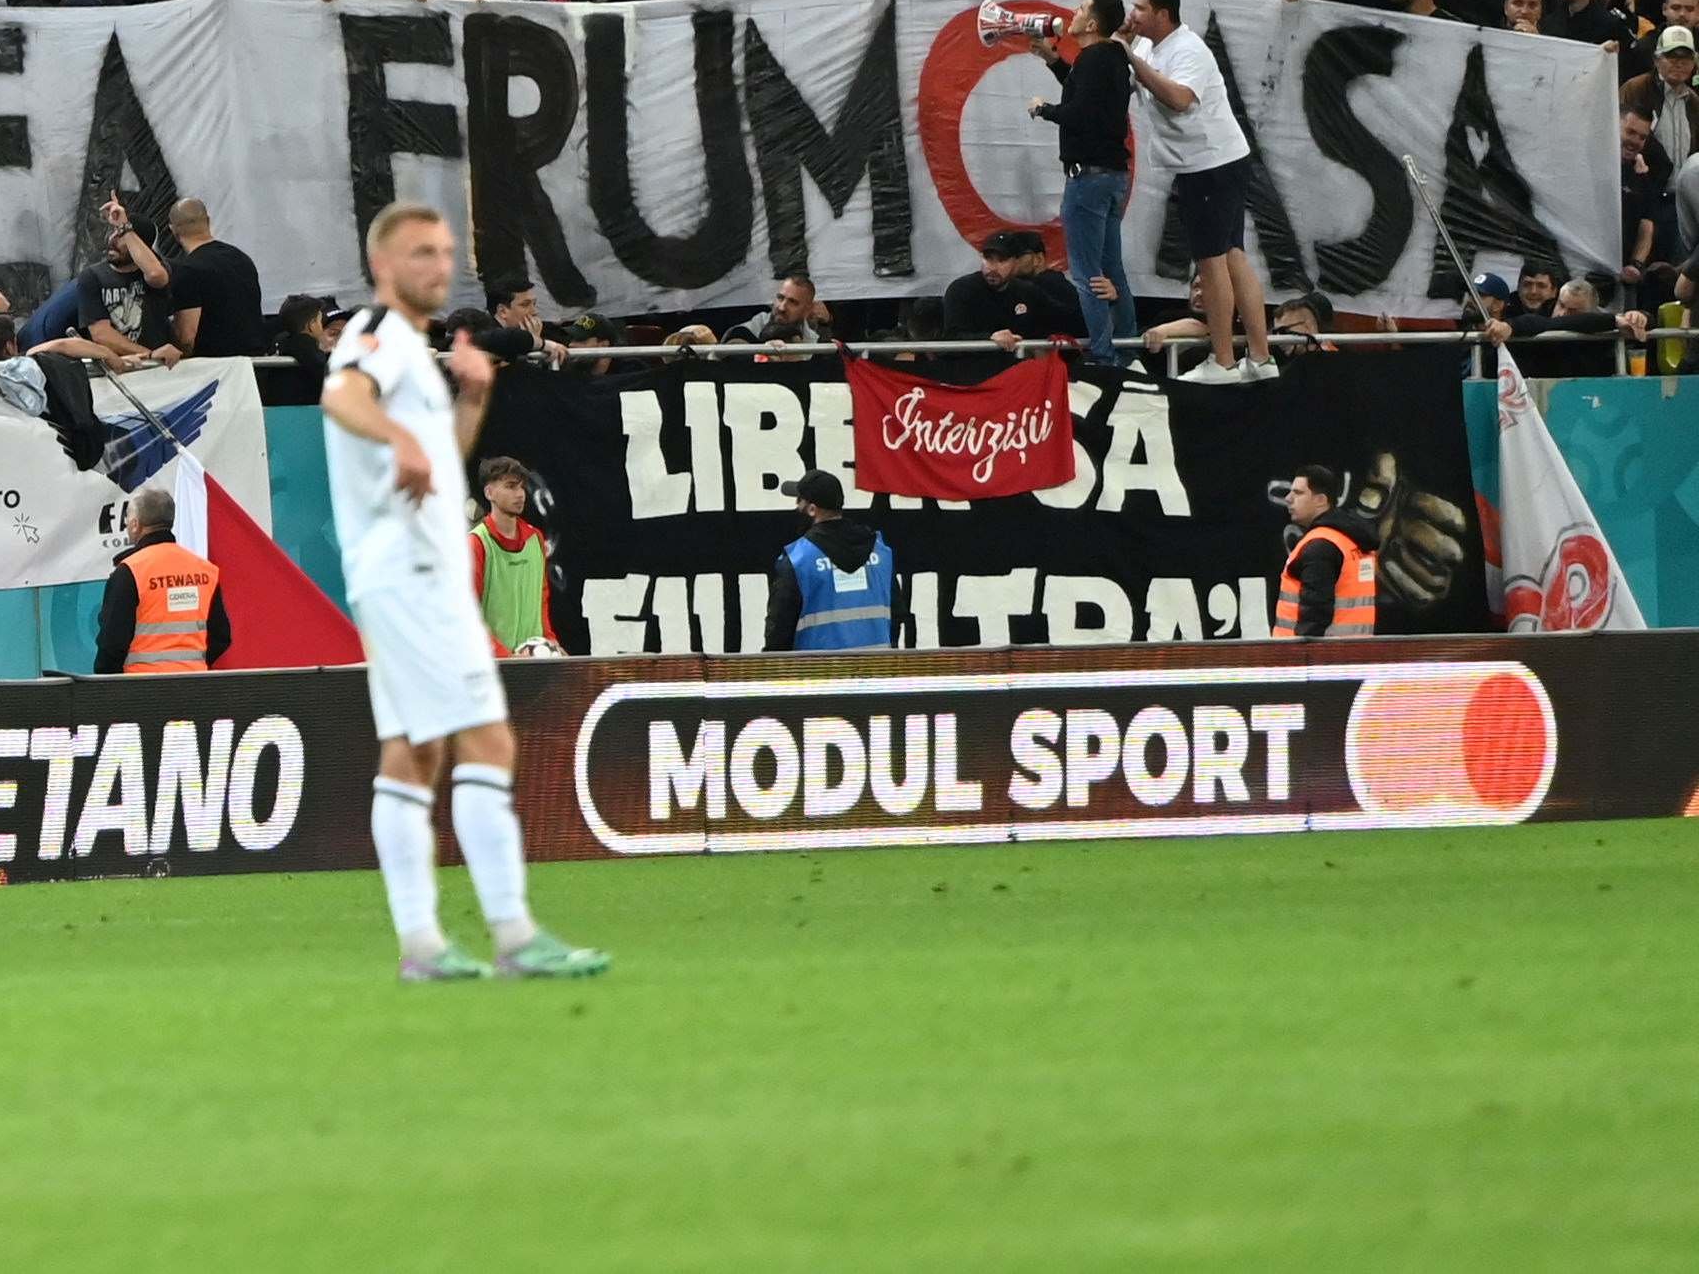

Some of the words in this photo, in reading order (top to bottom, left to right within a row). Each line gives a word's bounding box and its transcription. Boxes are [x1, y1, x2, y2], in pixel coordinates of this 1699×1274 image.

[149, 573, 210, 591] STEWARD
[647, 711, 983, 823] MODUL
[1007, 702, 1309, 812] SPORT
